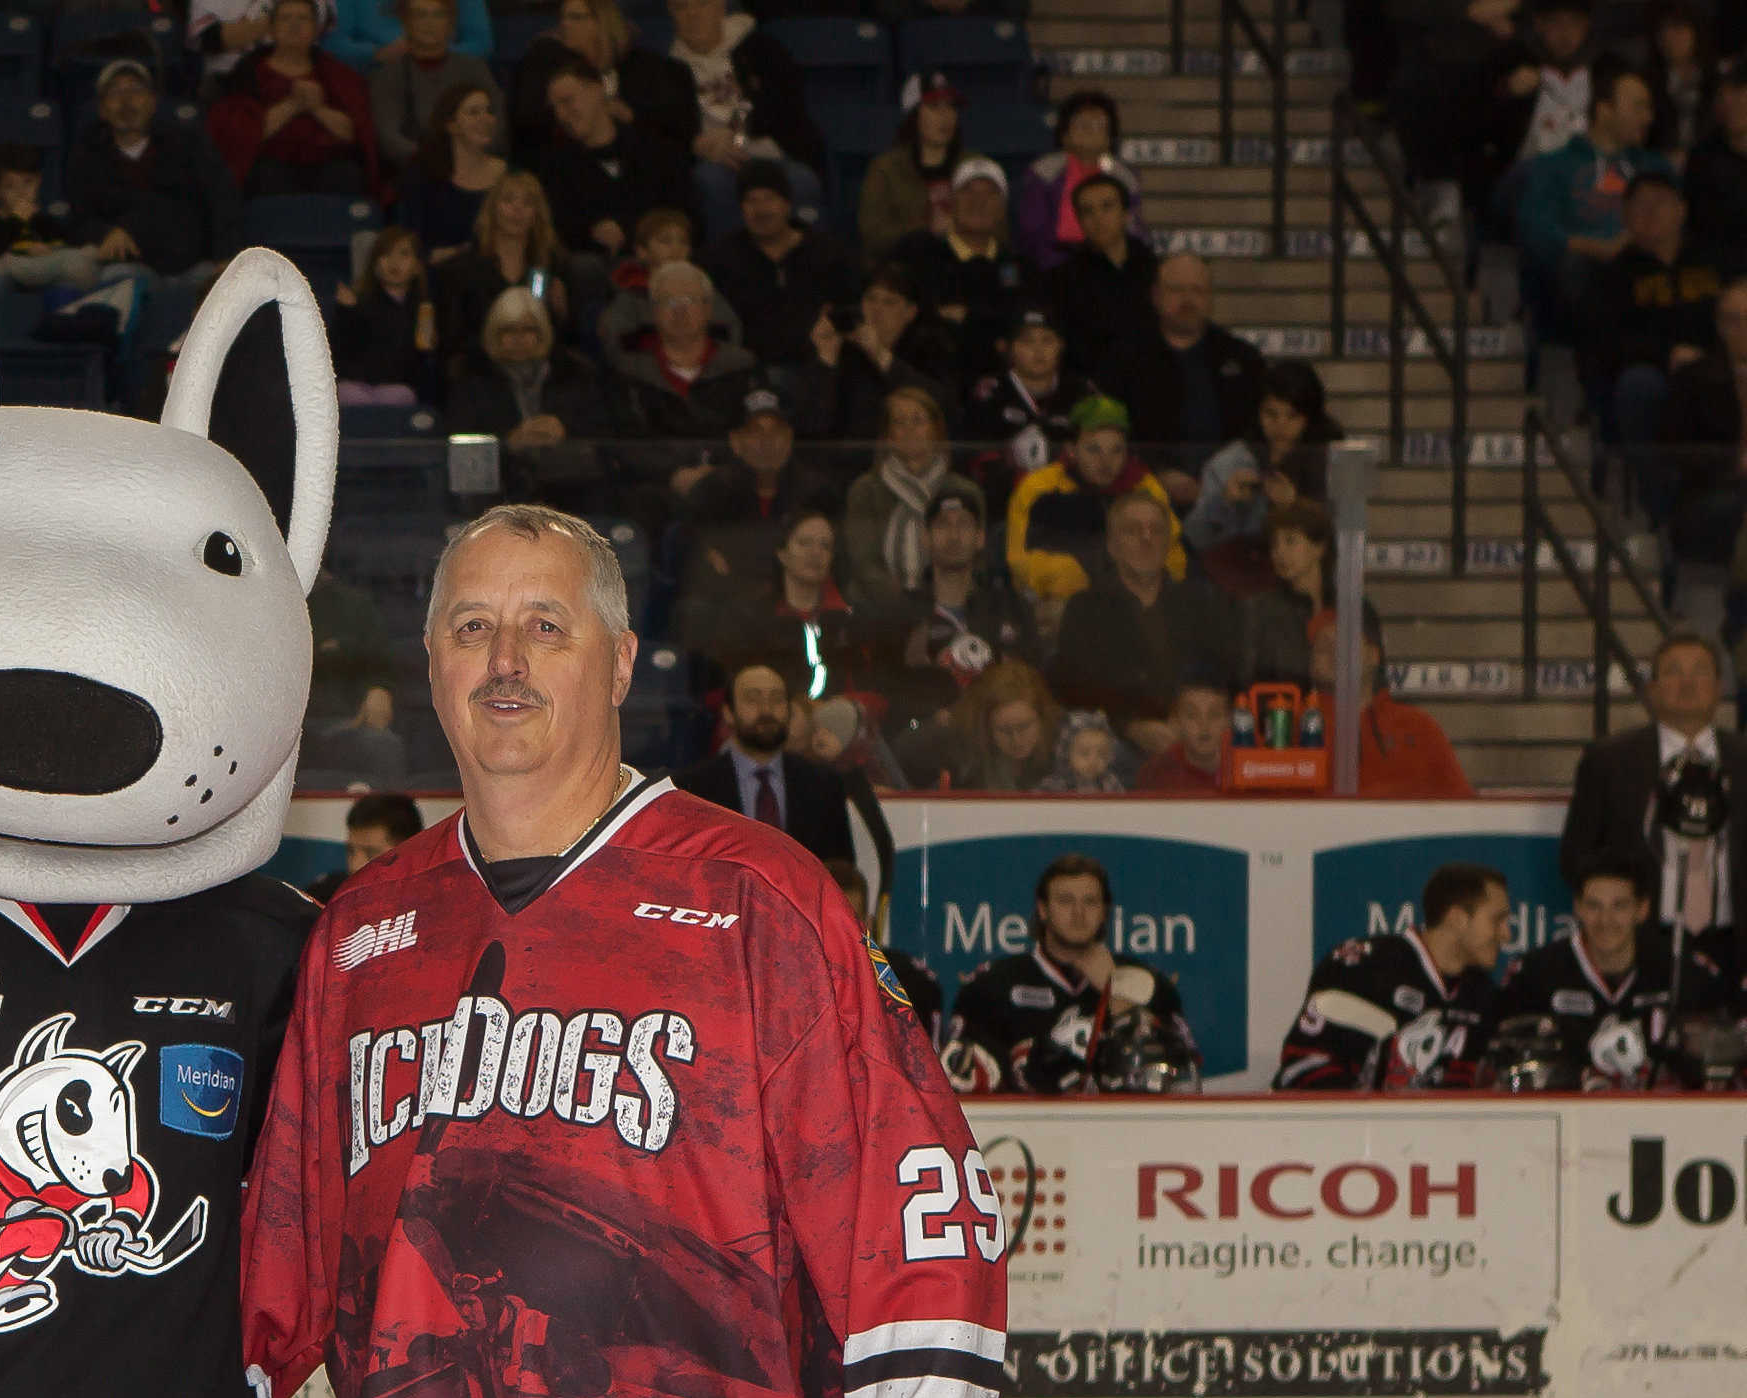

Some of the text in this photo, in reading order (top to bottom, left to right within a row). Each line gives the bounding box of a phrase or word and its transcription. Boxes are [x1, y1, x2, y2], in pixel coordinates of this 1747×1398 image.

[633, 902, 740, 929] CCM
[943, 903, 1196, 953] Meian
[133, 996, 233, 1018] CCM
[176, 1064, 236, 1091] Meridian
[899, 1147, 1007, 1263] 29
[1137, 1162, 1477, 1219] RICOH
[1606, 1136, 1747, 1229] Jo
[1138, 1234, 1488, 1276] imagine. change.
